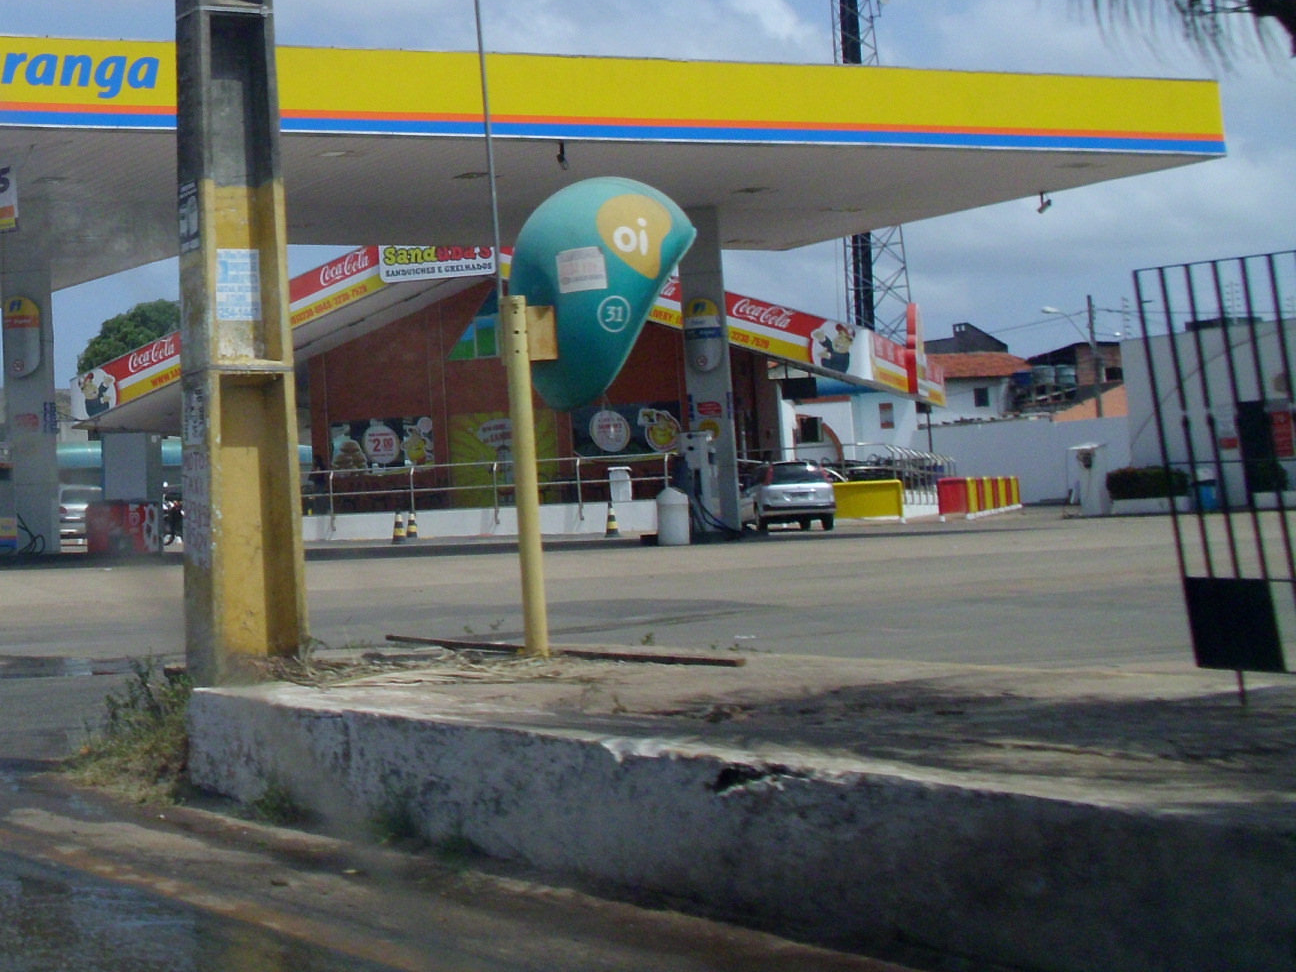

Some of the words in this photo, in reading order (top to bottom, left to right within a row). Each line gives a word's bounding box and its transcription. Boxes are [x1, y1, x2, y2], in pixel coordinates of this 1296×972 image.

[320, 248, 370, 286] Coca-Cola
[605, 305, 624, 322] 31
[732, 298, 794, 329] Coca-Cola
[128, 337, 175, 373] Coca-Cola
